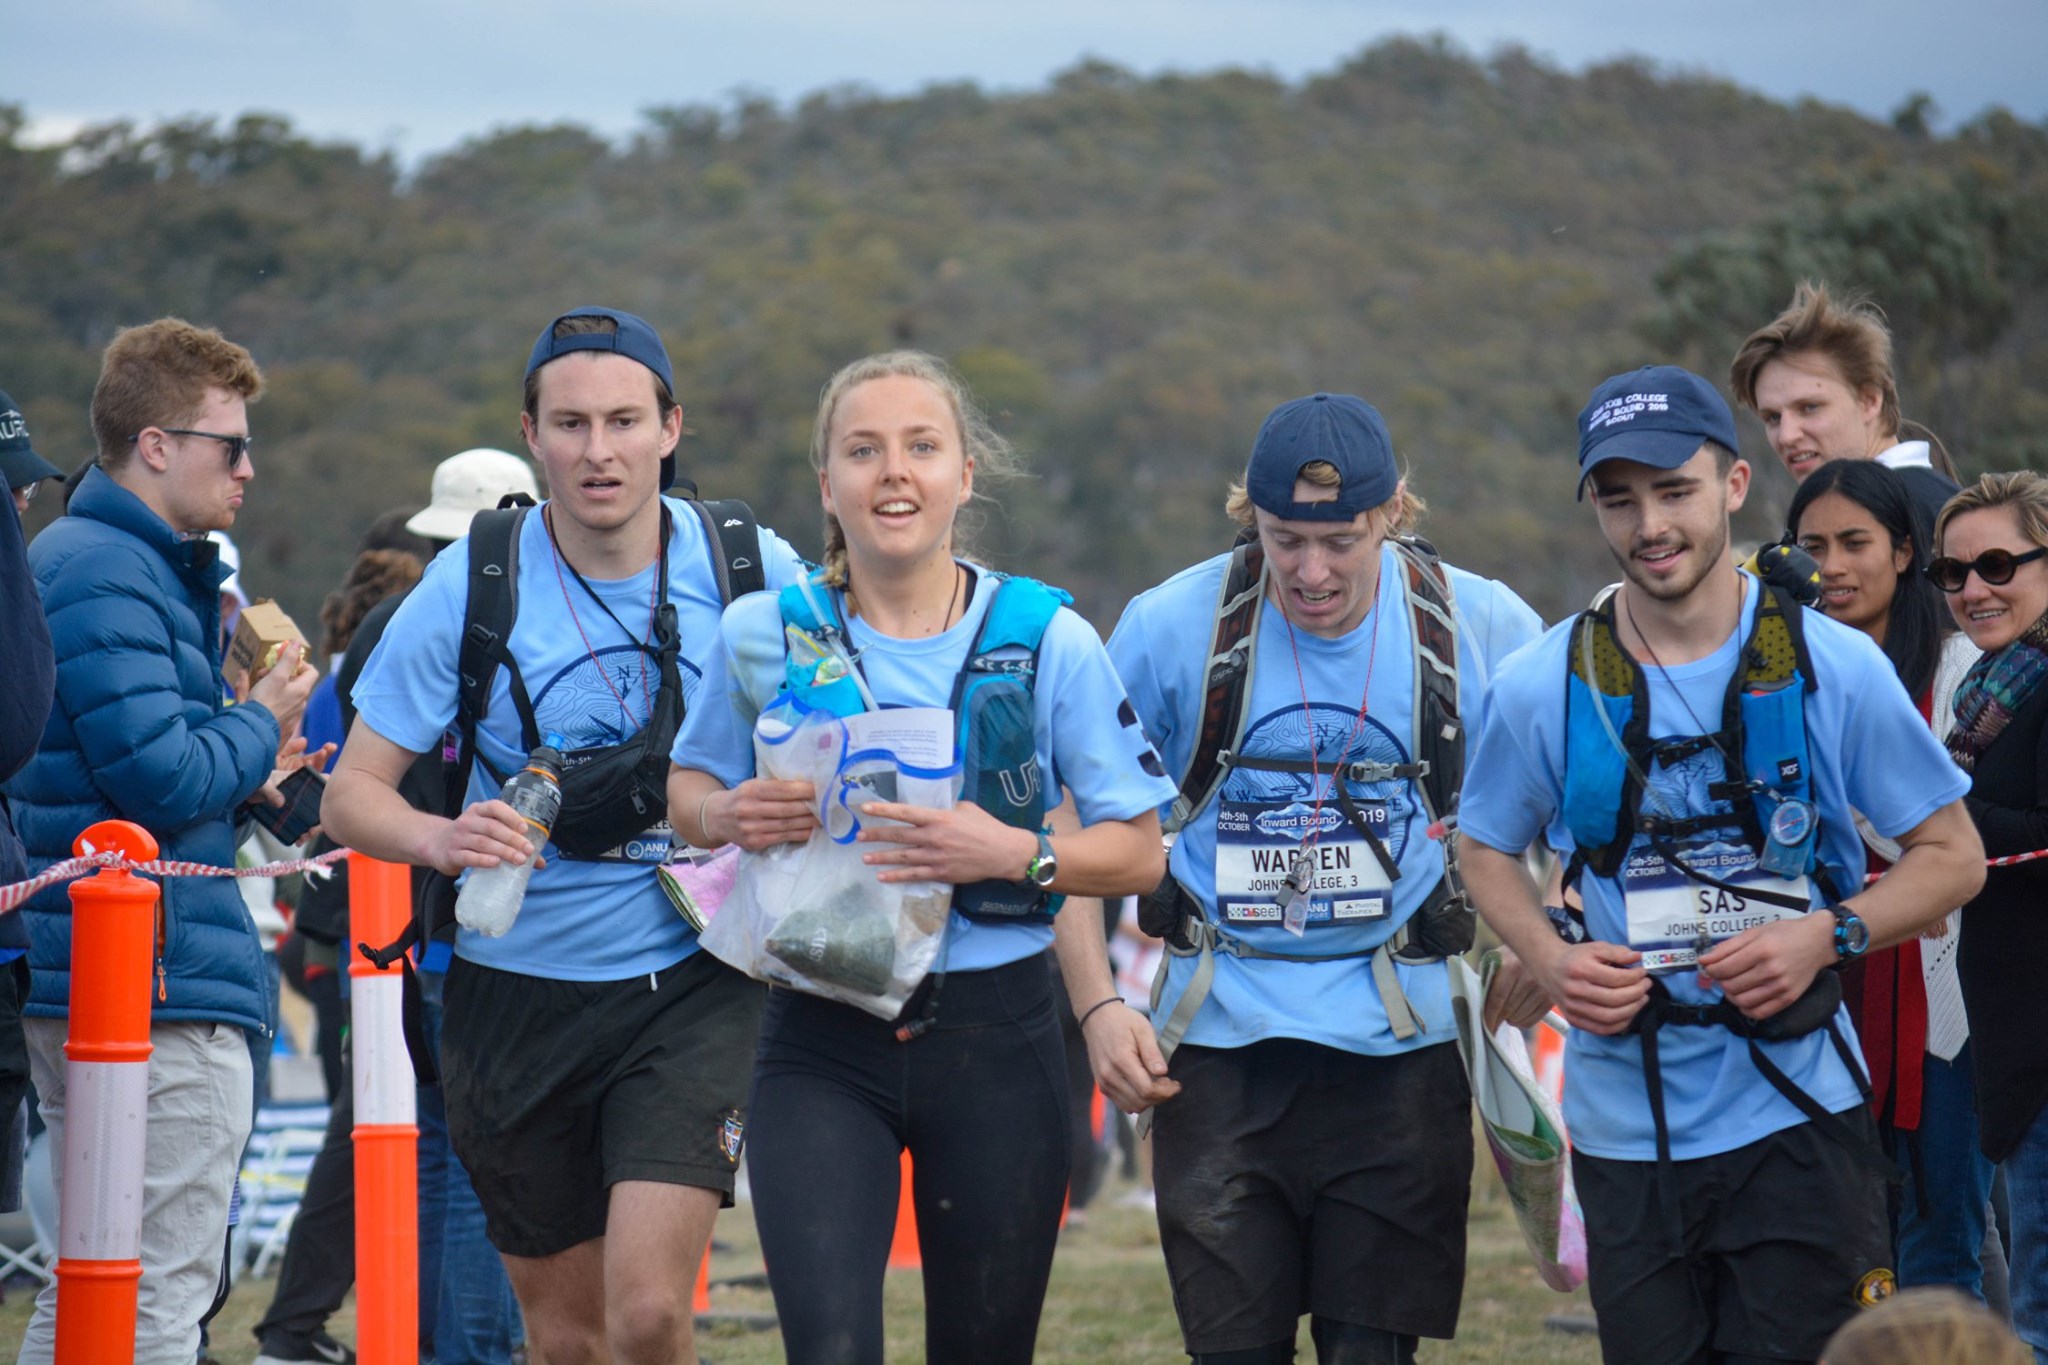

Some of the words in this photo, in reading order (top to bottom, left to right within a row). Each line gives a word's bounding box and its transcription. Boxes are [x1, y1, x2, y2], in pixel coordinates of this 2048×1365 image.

[1625, 393, 1668, 403] COLLEGE
[1647, 402, 1669, 411] 2019
[616, 664, 631, 680] N
[1315, 723, 1329, 738] N
[1219, 811, 1249, 822] 4th-5th
[1260, 816, 1298, 828] Inward
[1299, 814, 1337, 827] Bound
[1217, 822, 1251, 832] OCTOBER
[644, 842, 669, 853] ANU
[1720, 853, 1757, 866] Bound
[1626, 866, 1667, 878] OCTOBER
[1350, 875, 1359, 888] 3
[1698, 890, 1746, 914] SAS
[1664, 921, 1709, 937] JOHNS
